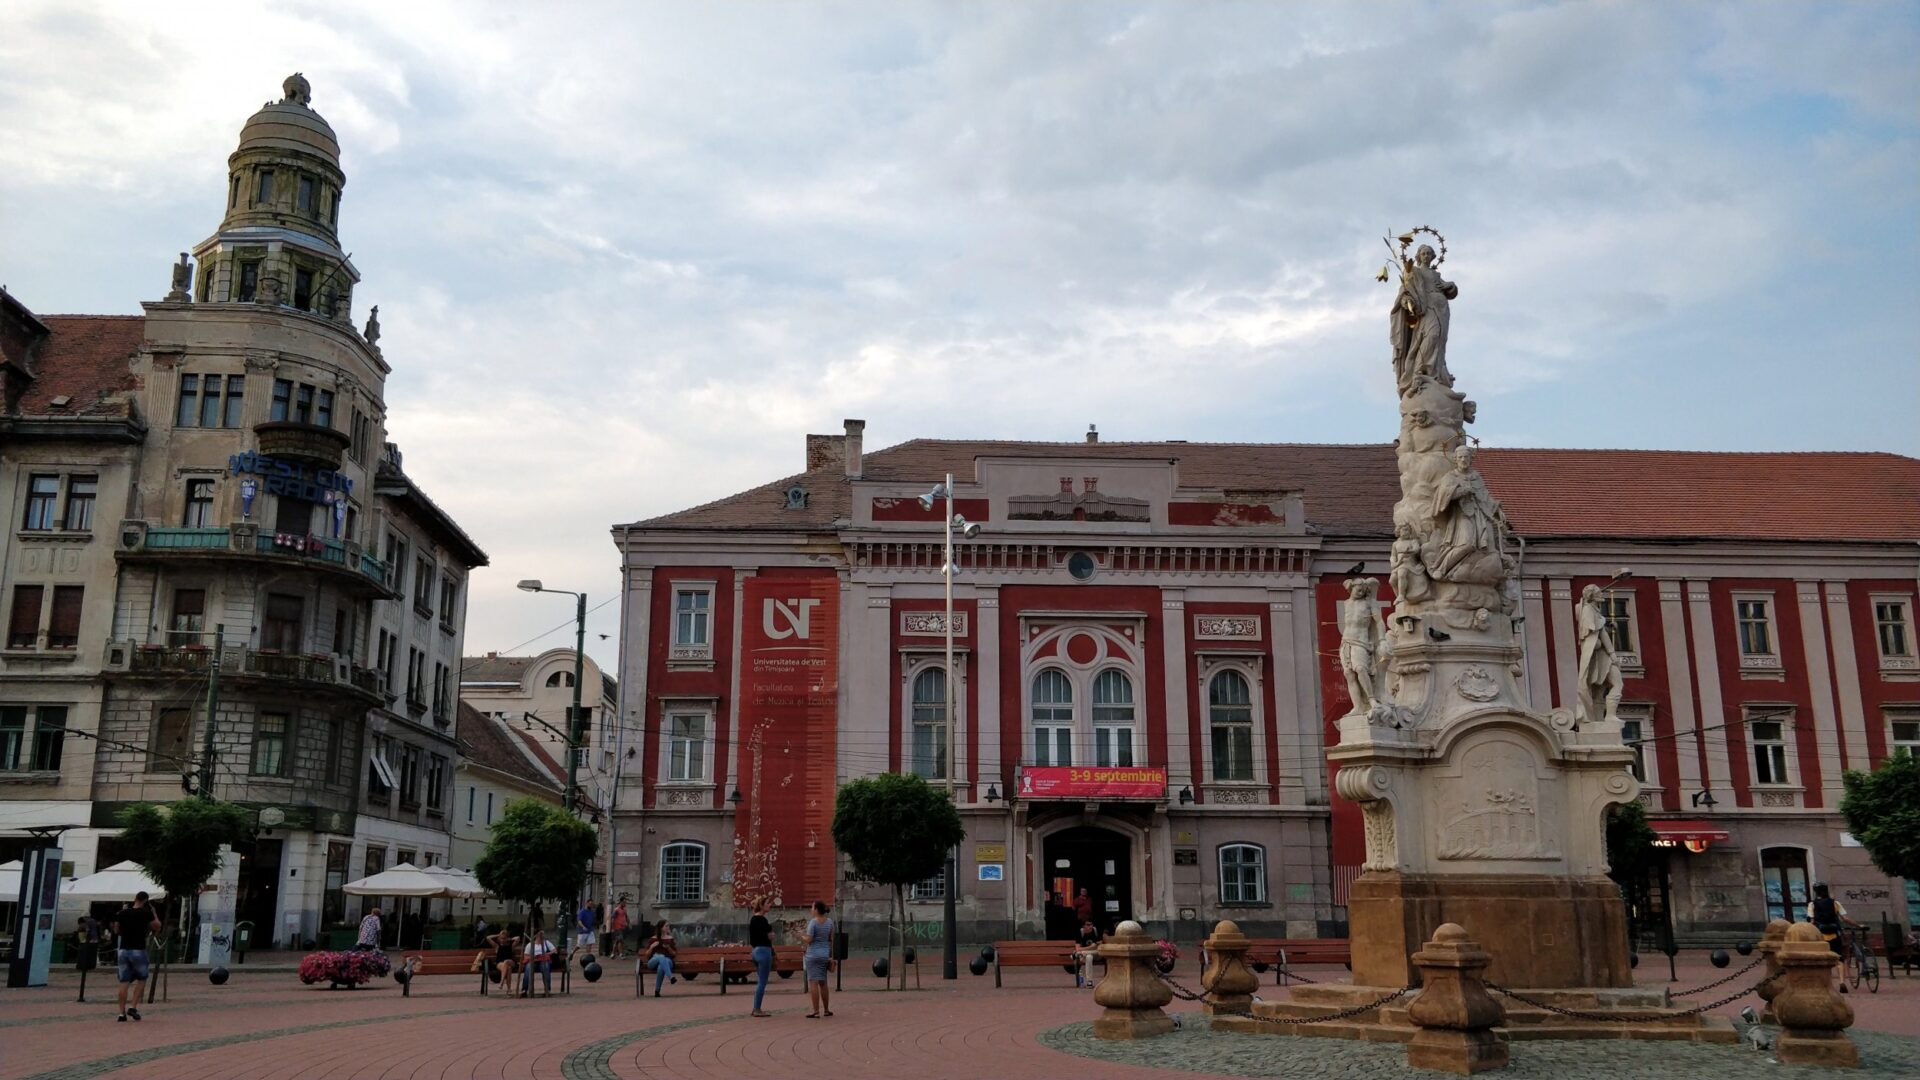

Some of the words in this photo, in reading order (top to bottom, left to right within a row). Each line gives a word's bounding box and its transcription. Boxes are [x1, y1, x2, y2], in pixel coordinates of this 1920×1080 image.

[229, 450, 306, 479] WEST
[315, 467, 353, 495] CITY
[753, 658, 800, 666] Universitatea
[801, 658, 810, 666] de
[811, 658, 826, 666] Vest
[1070, 770, 1091, 782] 3-9
[1094, 770, 1162, 784] septembrie
